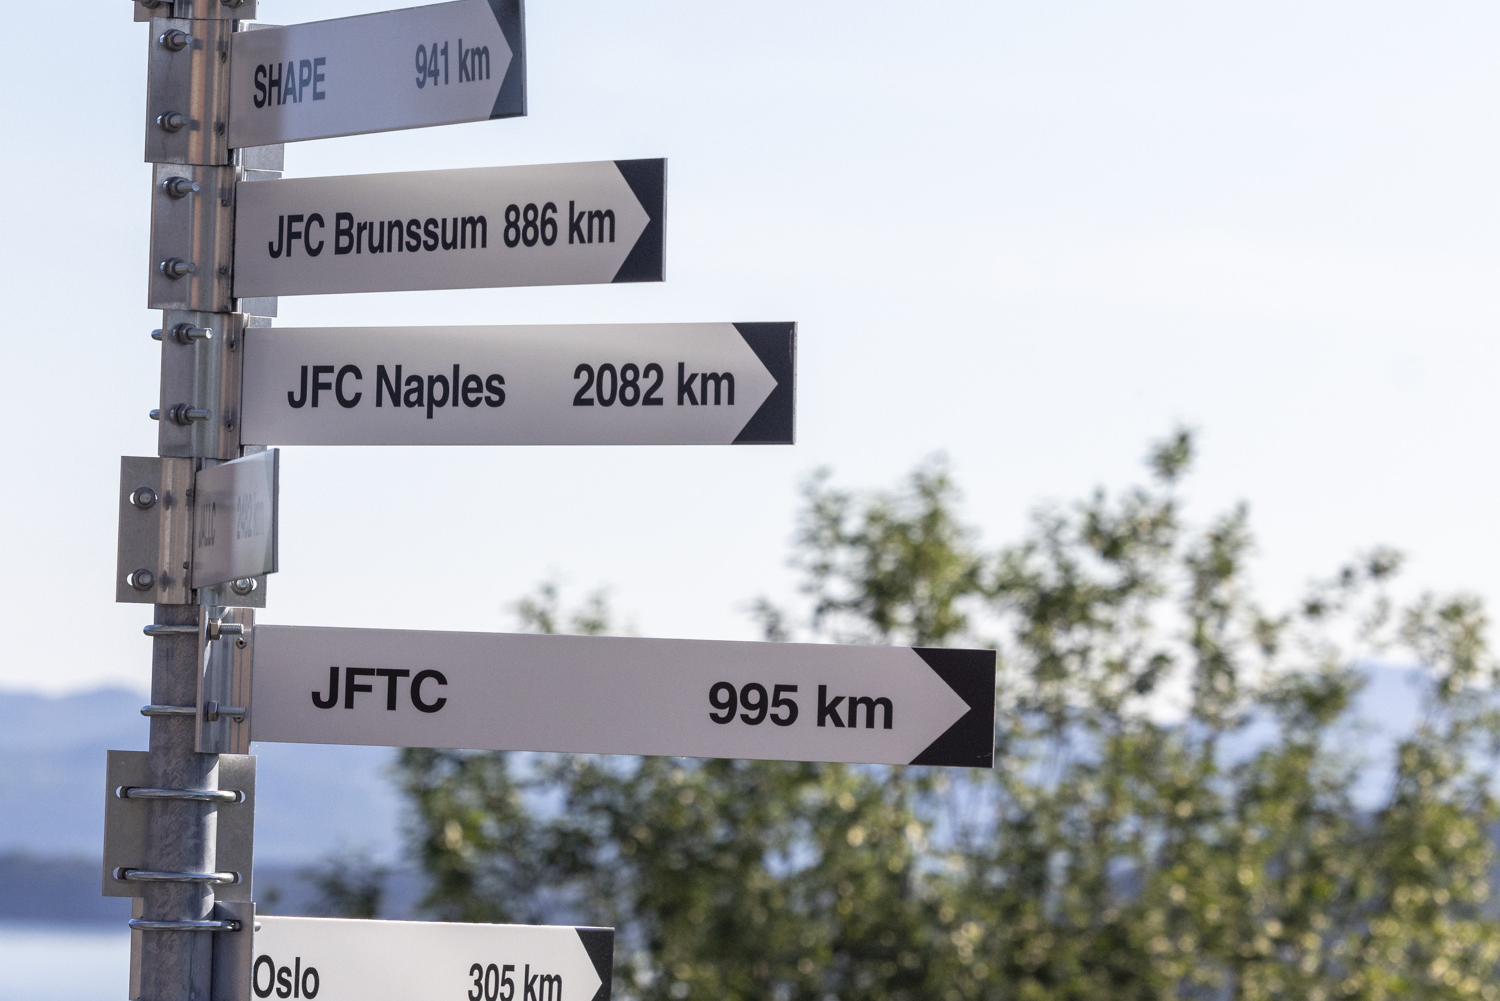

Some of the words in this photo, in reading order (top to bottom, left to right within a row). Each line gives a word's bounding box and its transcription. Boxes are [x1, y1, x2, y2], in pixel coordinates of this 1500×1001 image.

[253, 57, 326, 109] SHAPE
[415, 41, 450, 89] 941
[458, 39, 490, 83] km
[268, 213, 325, 258] JFC
[334, 212, 488, 255] Brunssum
[503, 202, 558, 248] 886
[568, 200, 616, 245] km
[287, 364, 363, 409] JFC
[376, 364, 506, 419] Naples
[572, 363, 664, 407] 2082
[677, 362, 735, 406] km
[311, 666, 448, 713] JFTC
[708, 681, 800, 727] 995
[816, 684, 894, 729] km
[253, 954, 320, 999] Oslo
[468, 963, 515, 1001] 305
[523, 964, 563, 1001] km
